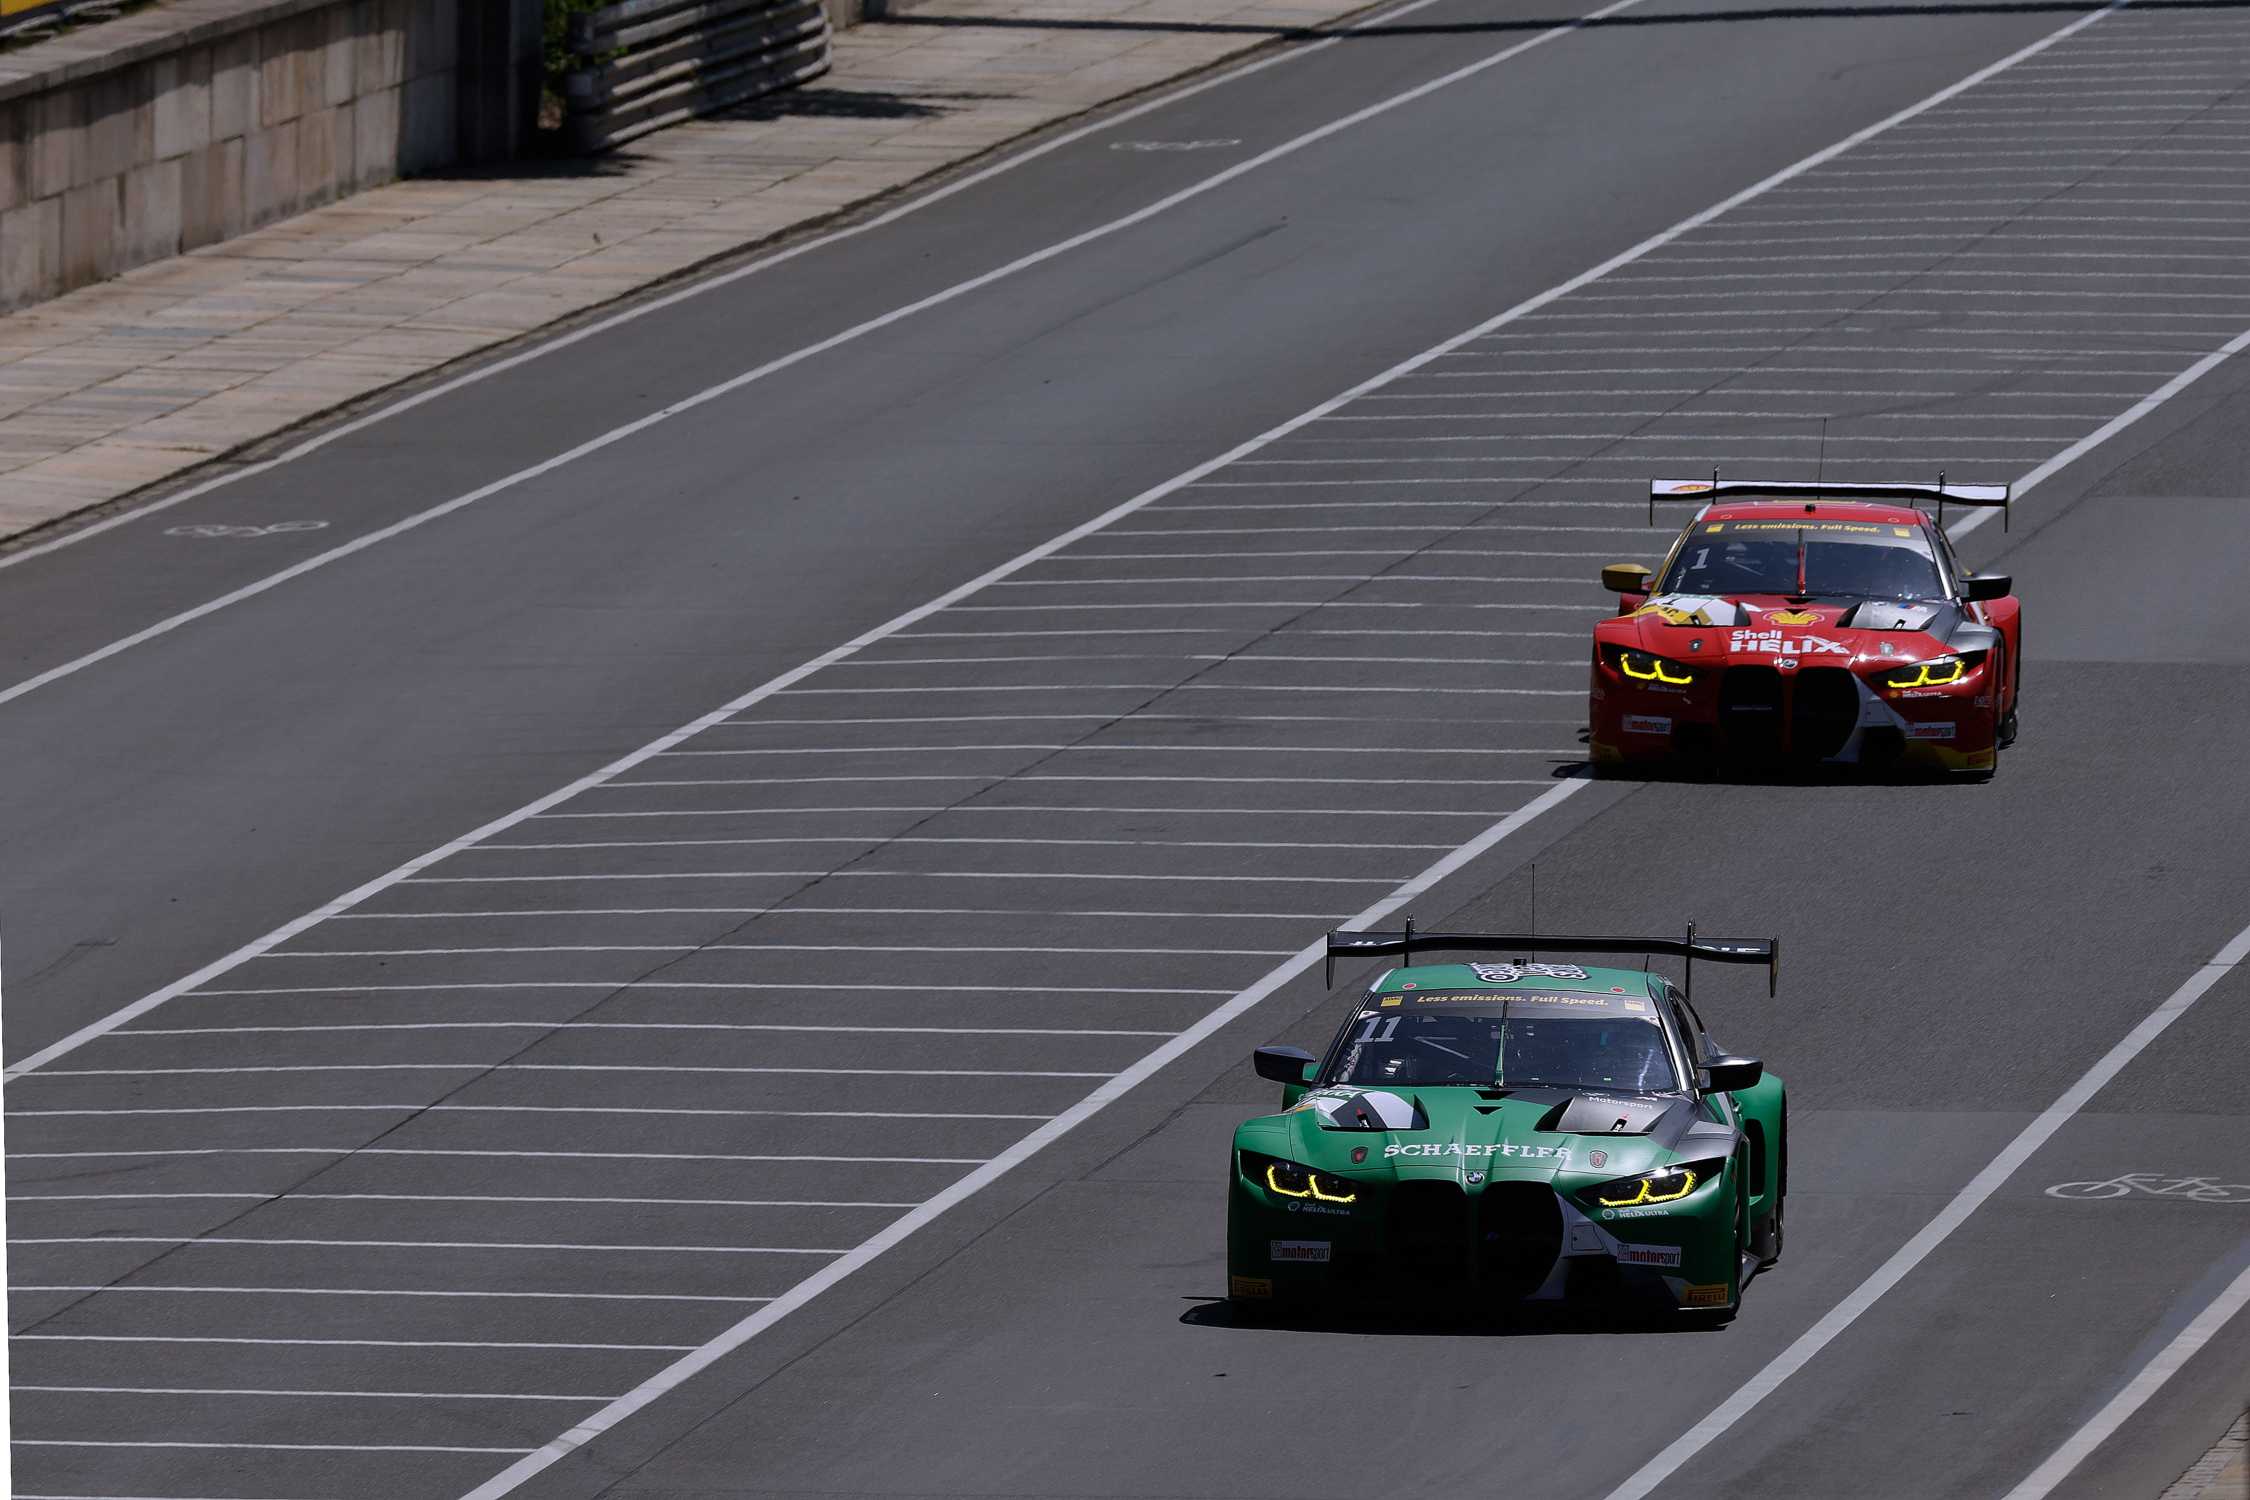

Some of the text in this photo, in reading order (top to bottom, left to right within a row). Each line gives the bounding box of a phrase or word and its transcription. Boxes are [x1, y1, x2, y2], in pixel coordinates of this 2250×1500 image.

[1691, 548, 1710, 570] 1
[1731, 630, 1783, 640] Shell
[1730, 635, 1851, 654] HELIX
[1451, 994, 1526, 1002] emissions.
[1560, 997, 1609, 1006] Speed.
[1354, 1016, 1402, 1043] 11
[1589, 1096, 1653, 1110] Motorsport
[1384, 1143, 1572, 1160] SCHAEFFLER
[1630, 1249, 1680, 1265] motorsport
